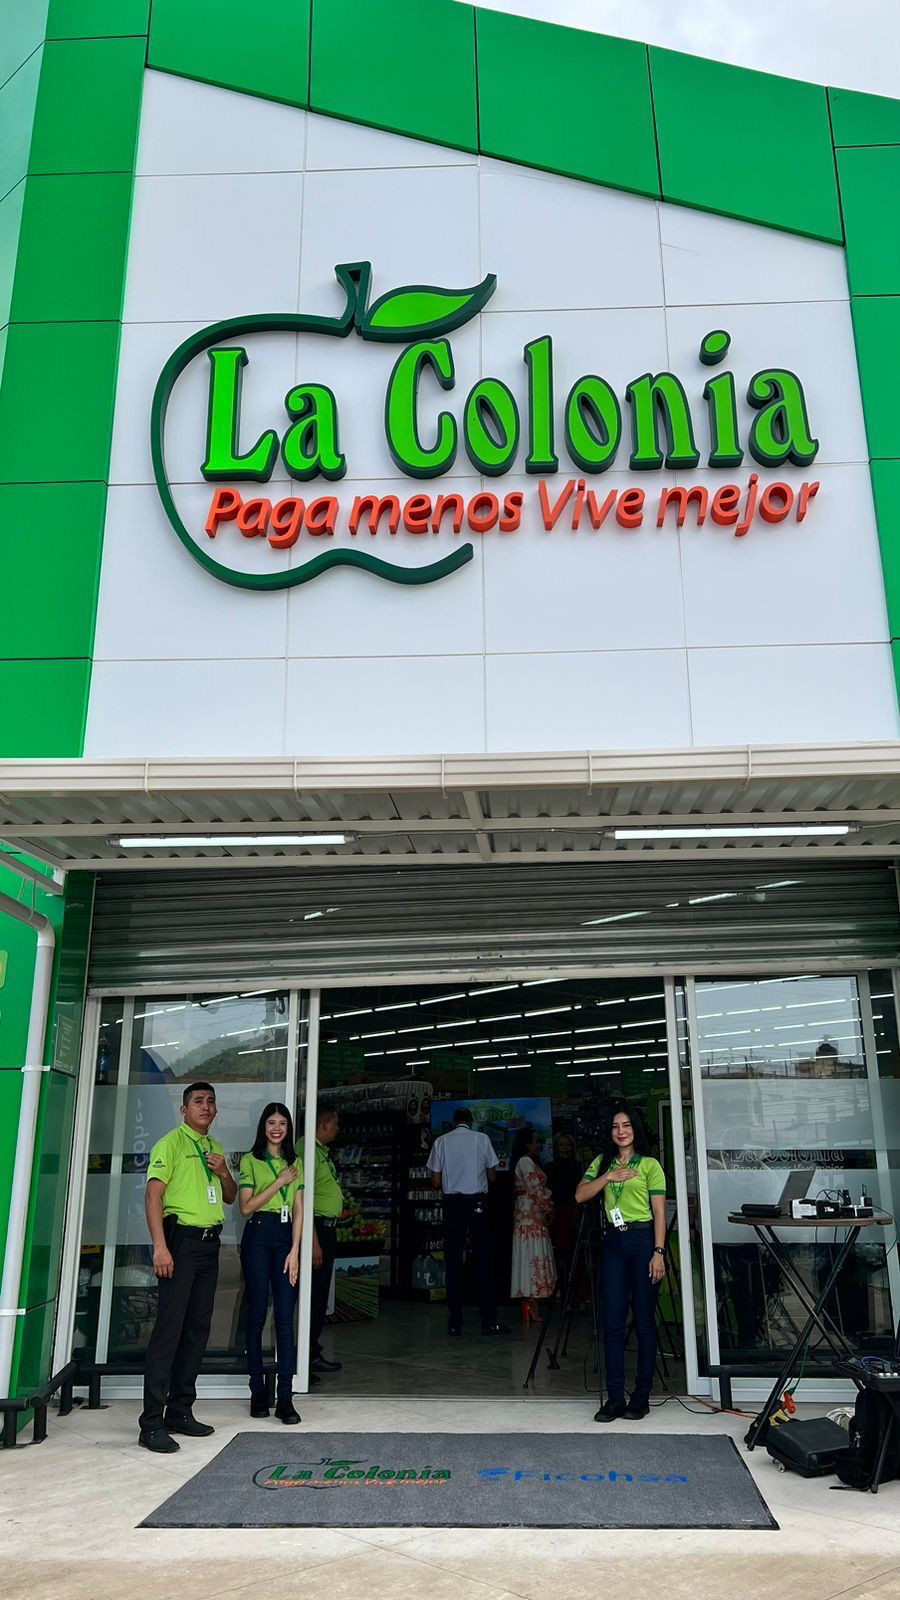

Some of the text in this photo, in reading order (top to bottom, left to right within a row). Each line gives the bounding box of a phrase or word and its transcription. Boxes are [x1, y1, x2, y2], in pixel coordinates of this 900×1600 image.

[201, 330, 820, 485] La Colonia
[205, 474, 819, 549] Paga menos Vive mejor
[268, 1465, 451, 1480] La Colonia
